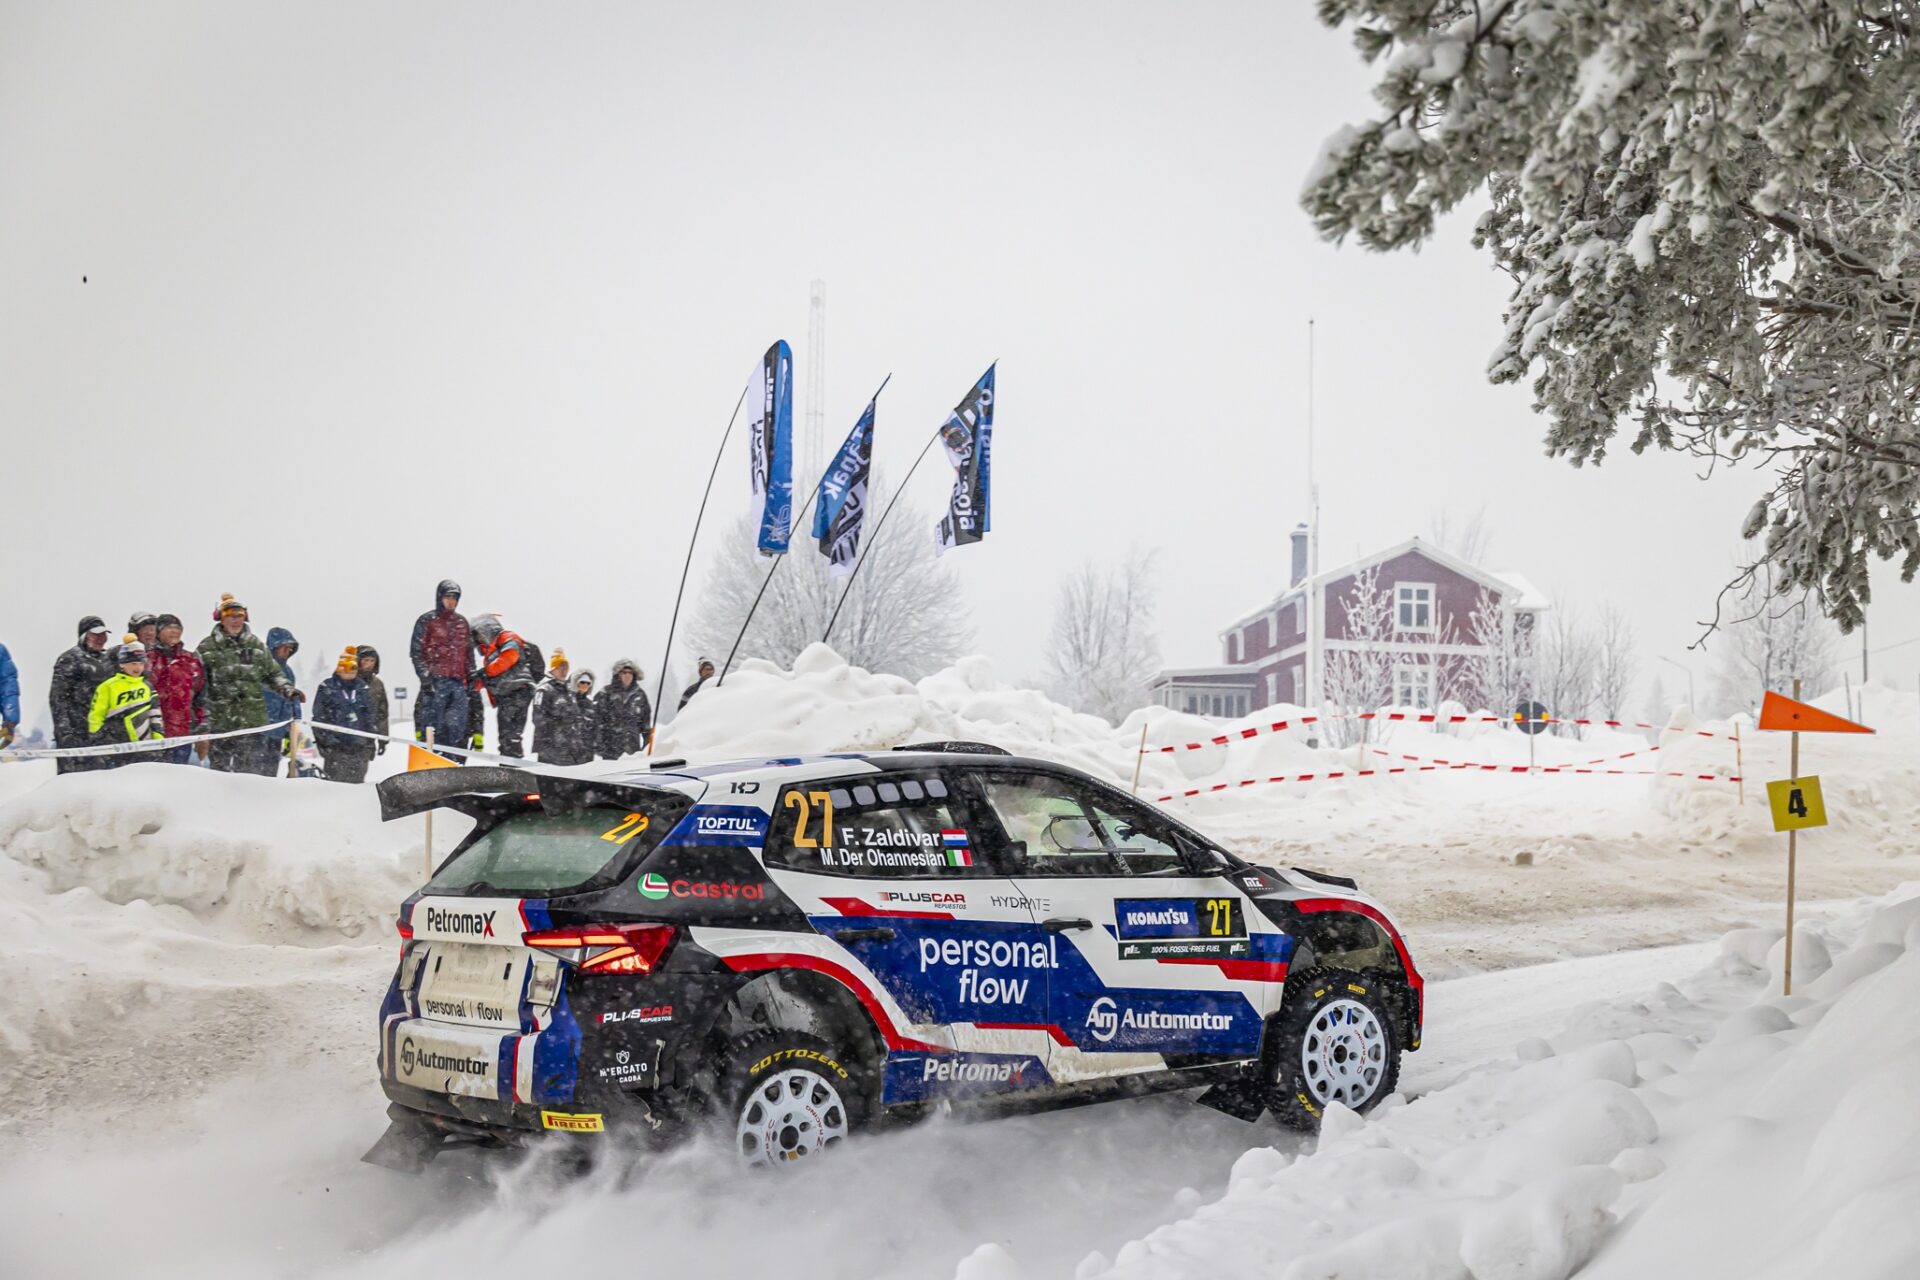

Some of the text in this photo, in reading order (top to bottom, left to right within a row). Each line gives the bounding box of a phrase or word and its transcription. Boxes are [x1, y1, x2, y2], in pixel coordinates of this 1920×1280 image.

[116, 688, 145, 705] FXR
[1788, 788, 1808, 818] 4
[600, 812, 649, 845] 27
[697, 817, 755, 830] TOPTUL
[784, 790, 833, 848] 27
[842, 828, 941, 847] F. Zaldivar
[820, 848, 946, 867] M. Der Ohannesian
[671, 880, 765, 900] Castrol
[889, 892, 966, 903] PLUSCAR
[1127, 900, 1231, 936] KOMATSU 27
[919, 935, 1059, 972] personal
[1151, 946, 1168, 954] 100%
[959, 969, 1029, 1005] flow
[426, 1000, 504, 1021] personal flow
[1121, 1008, 1233, 1030] Automotor
[416, 1048, 489, 1076] Automotor
[749, 1048, 849, 1079] SOTTOZERO
[547, 1115, 597, 1129] PIRELLI
